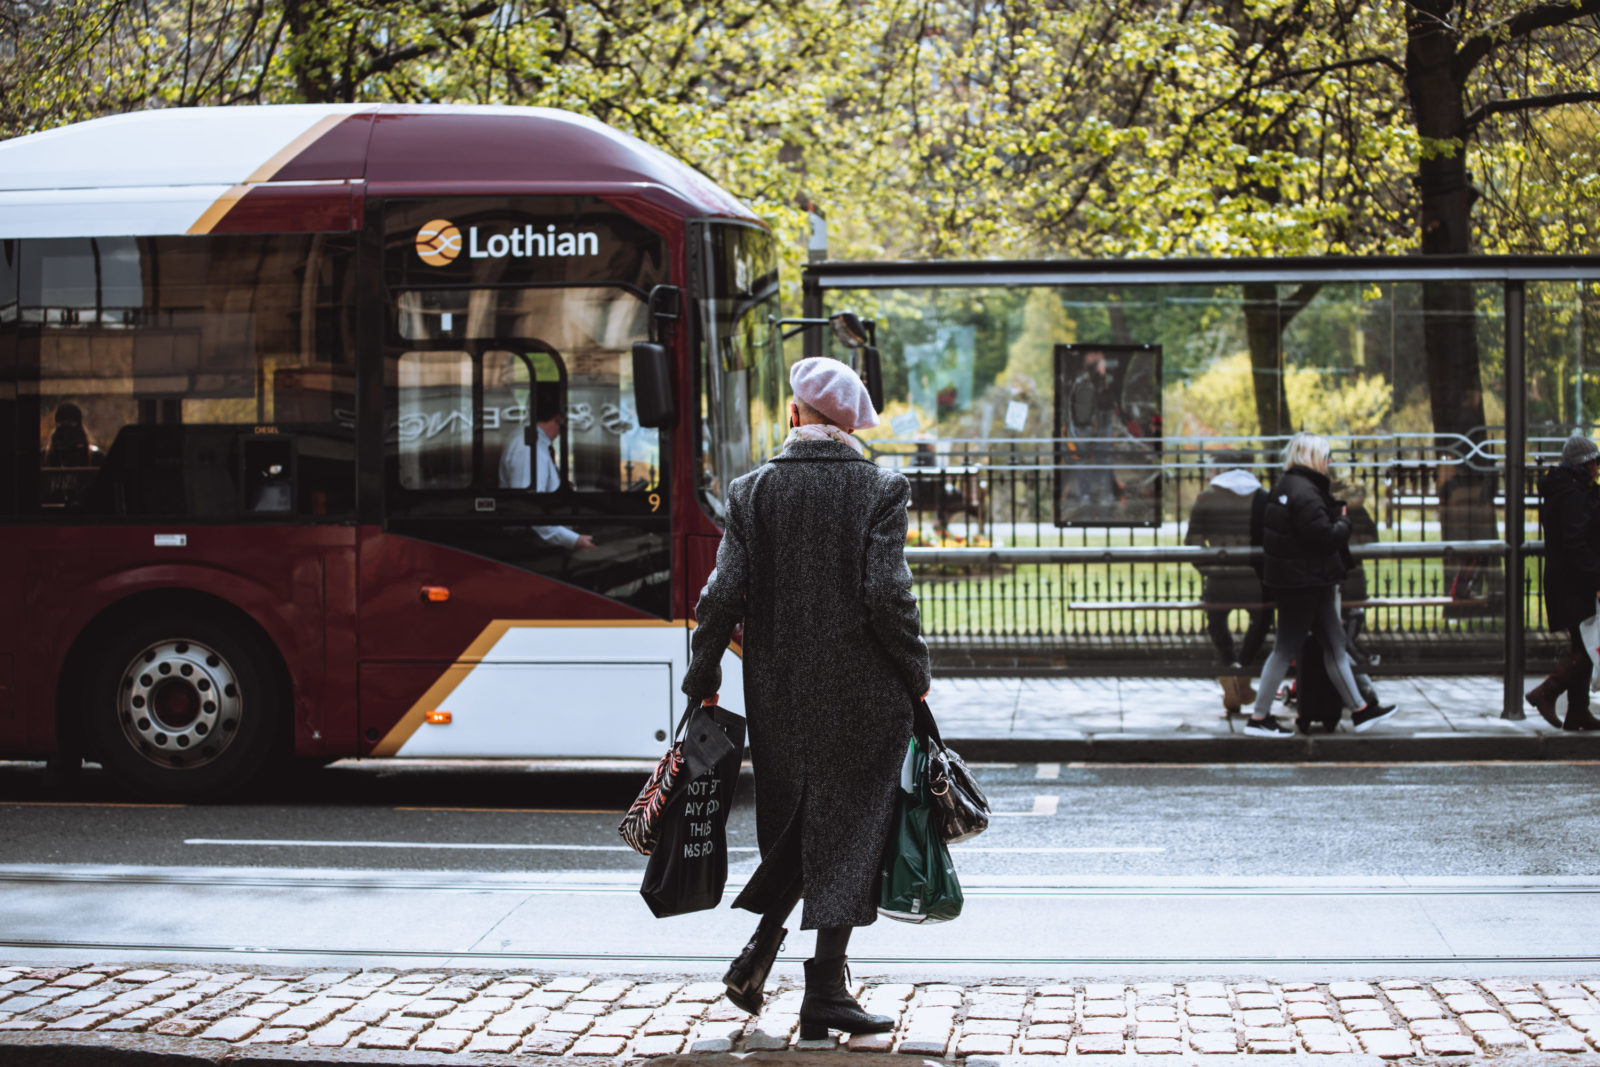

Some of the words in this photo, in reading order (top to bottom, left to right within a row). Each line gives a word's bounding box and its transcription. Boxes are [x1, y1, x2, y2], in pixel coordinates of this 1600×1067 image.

[469, 224, 600, 258] Lothian
[254, 426, 279, 434] DIESEL
[648, 493, 660, 512] 9
[687, 781, 708, 796] NOT
